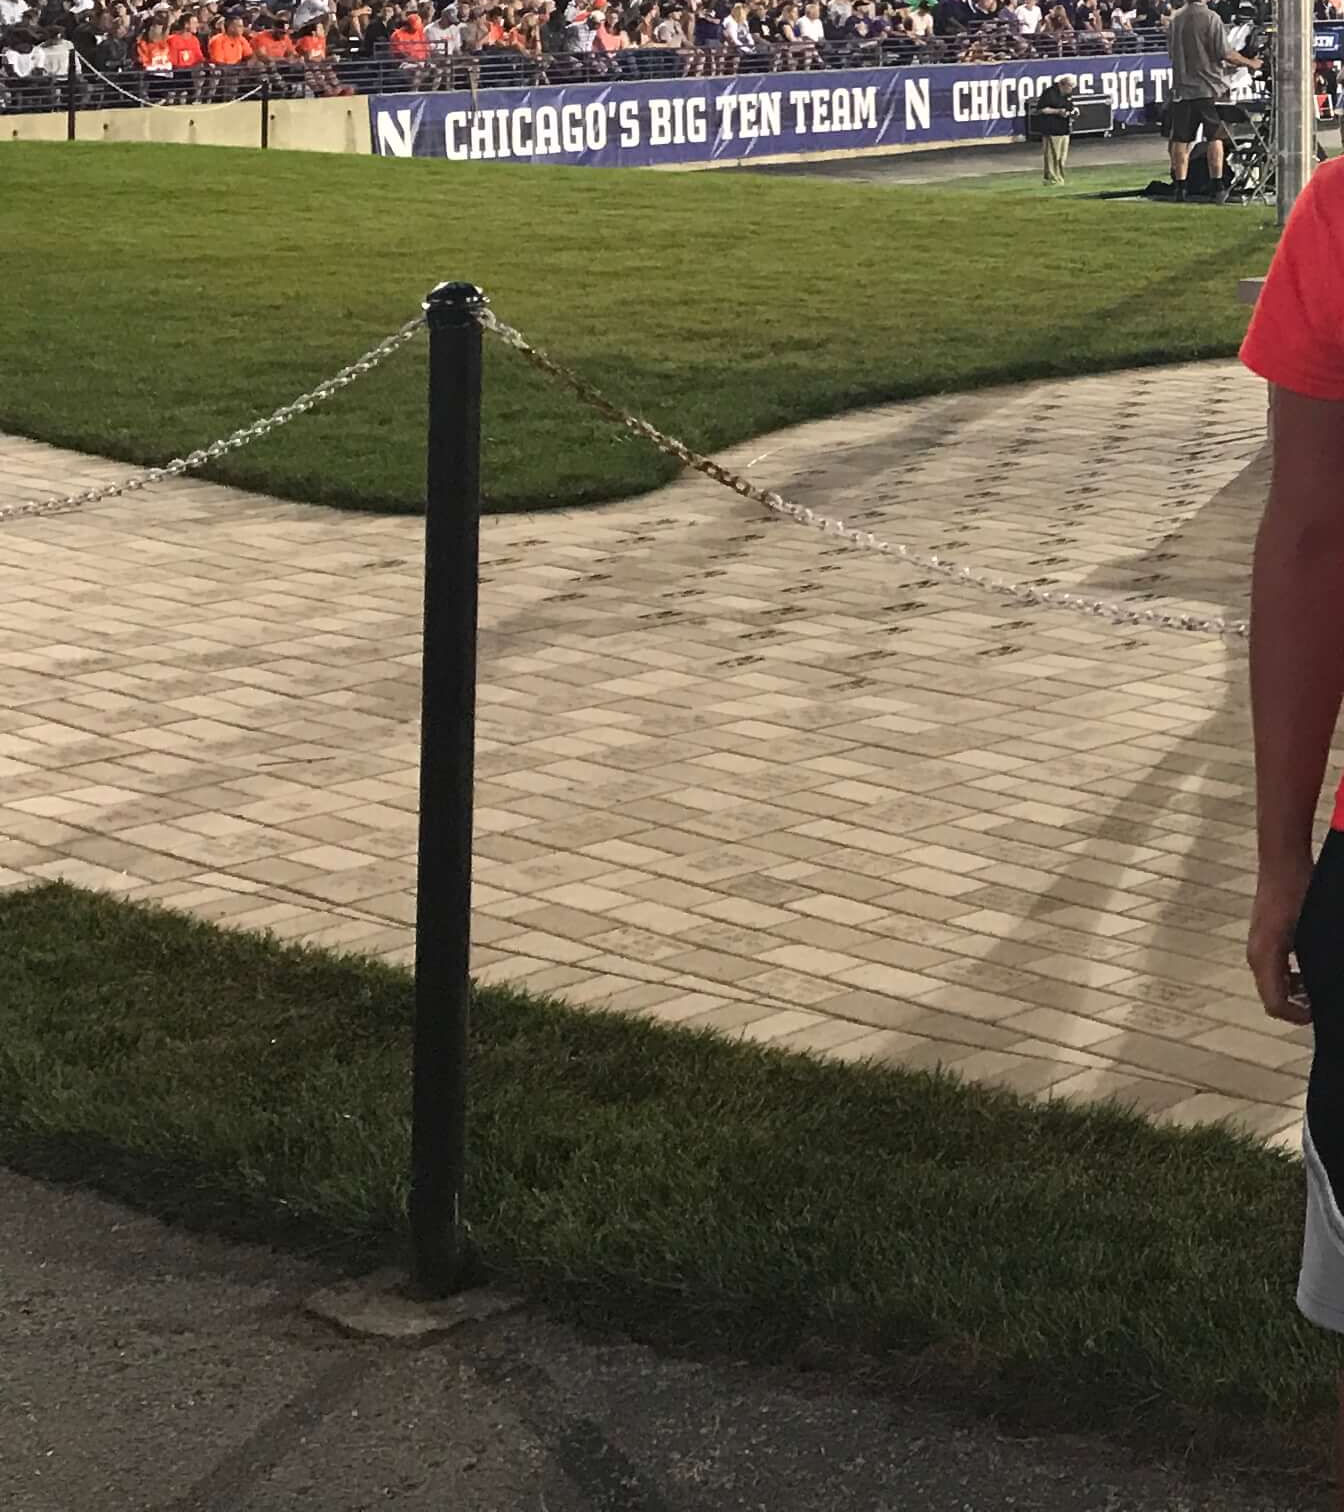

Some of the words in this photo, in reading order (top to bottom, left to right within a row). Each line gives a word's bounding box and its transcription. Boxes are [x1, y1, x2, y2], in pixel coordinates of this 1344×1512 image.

[376, 108, 412, 157] N
[444, 102, 640, 161] CHICAGO'S
[649, 96, 707, 146] BIG
[716, 91, 783, 140] TEN
[790, 86, 878, 134] TEAM
[904, 79, 931, 131] N
[1101, 69, 1144, 110] BIG
